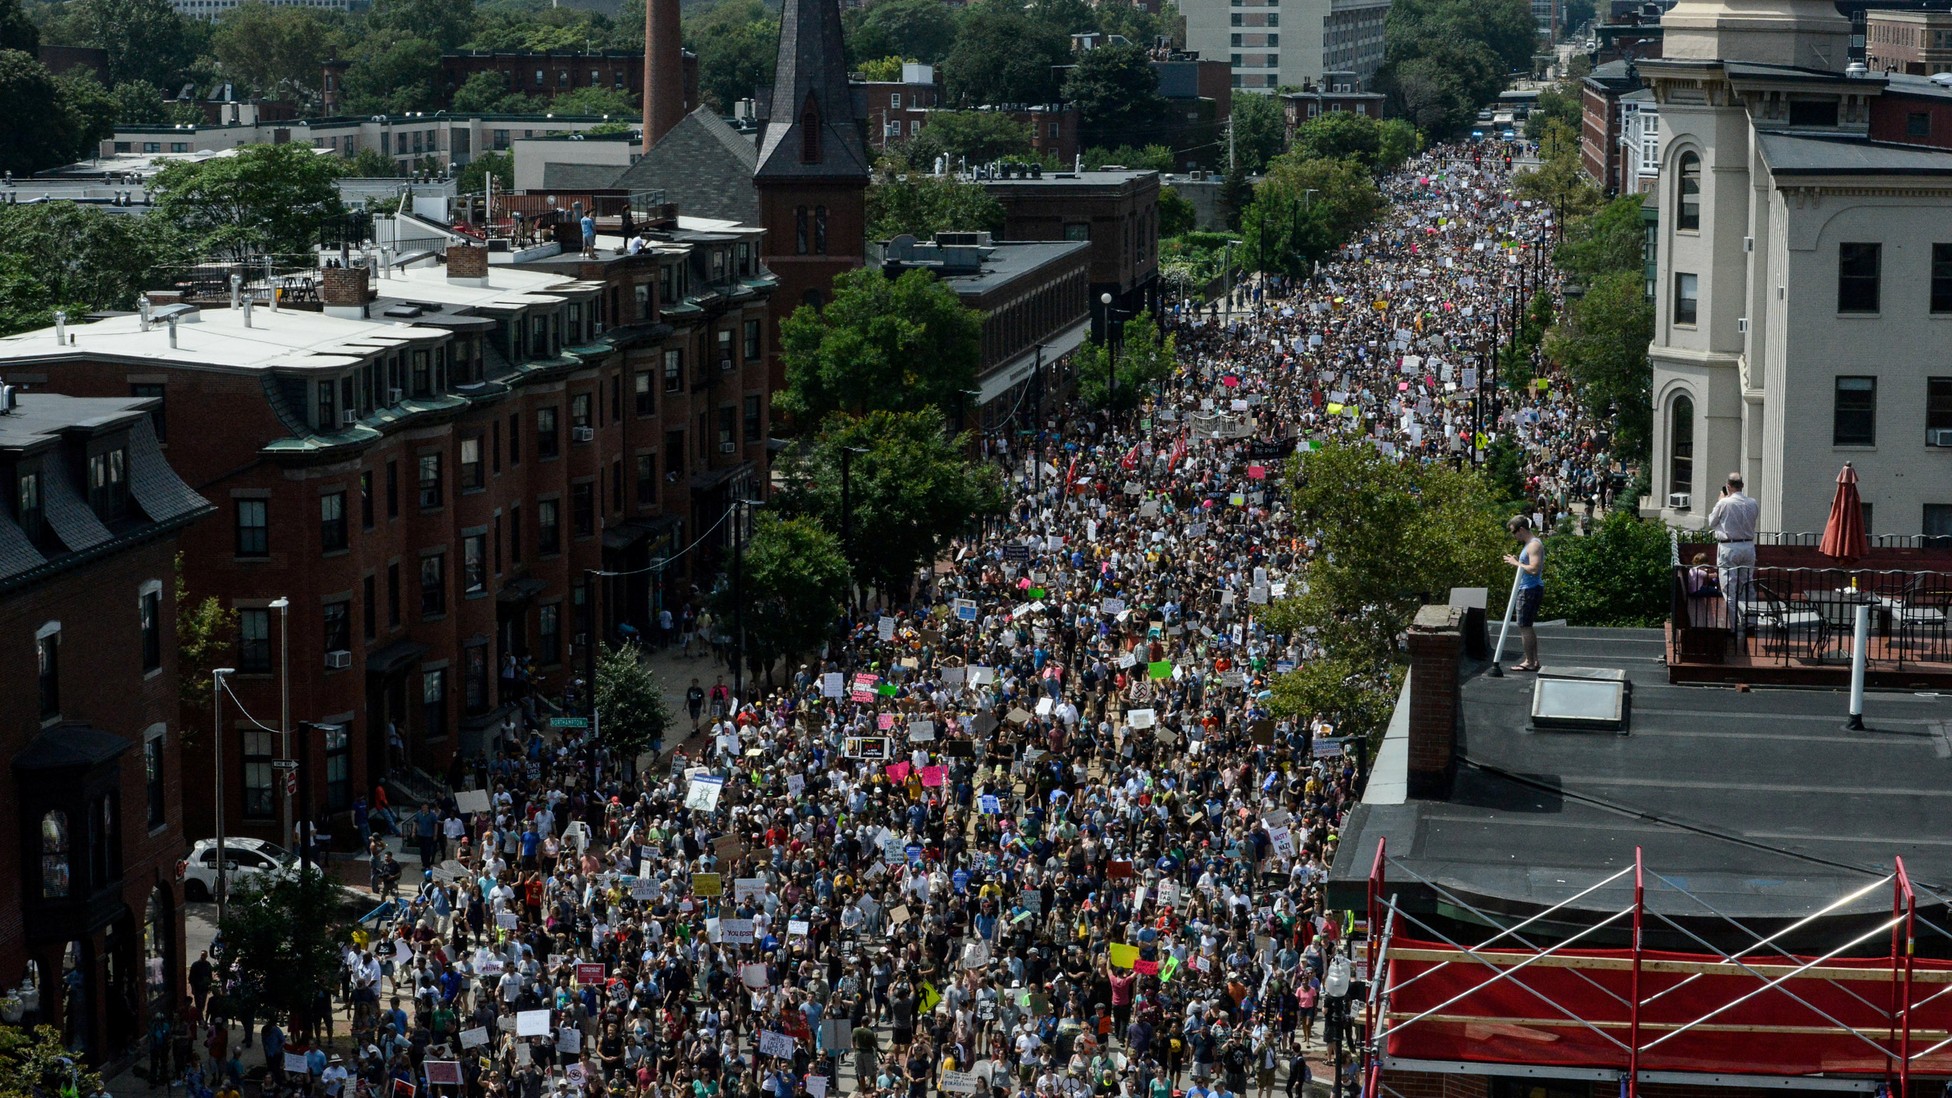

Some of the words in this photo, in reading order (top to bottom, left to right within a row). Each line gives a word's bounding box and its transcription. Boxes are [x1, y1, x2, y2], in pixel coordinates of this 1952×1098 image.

[1278, 843, 1291, 851] NAZI
[632, 880, 646, 888] END
[611, 982, 624, 991] NO
[762, 1045, 788, 1057] AMERICA
